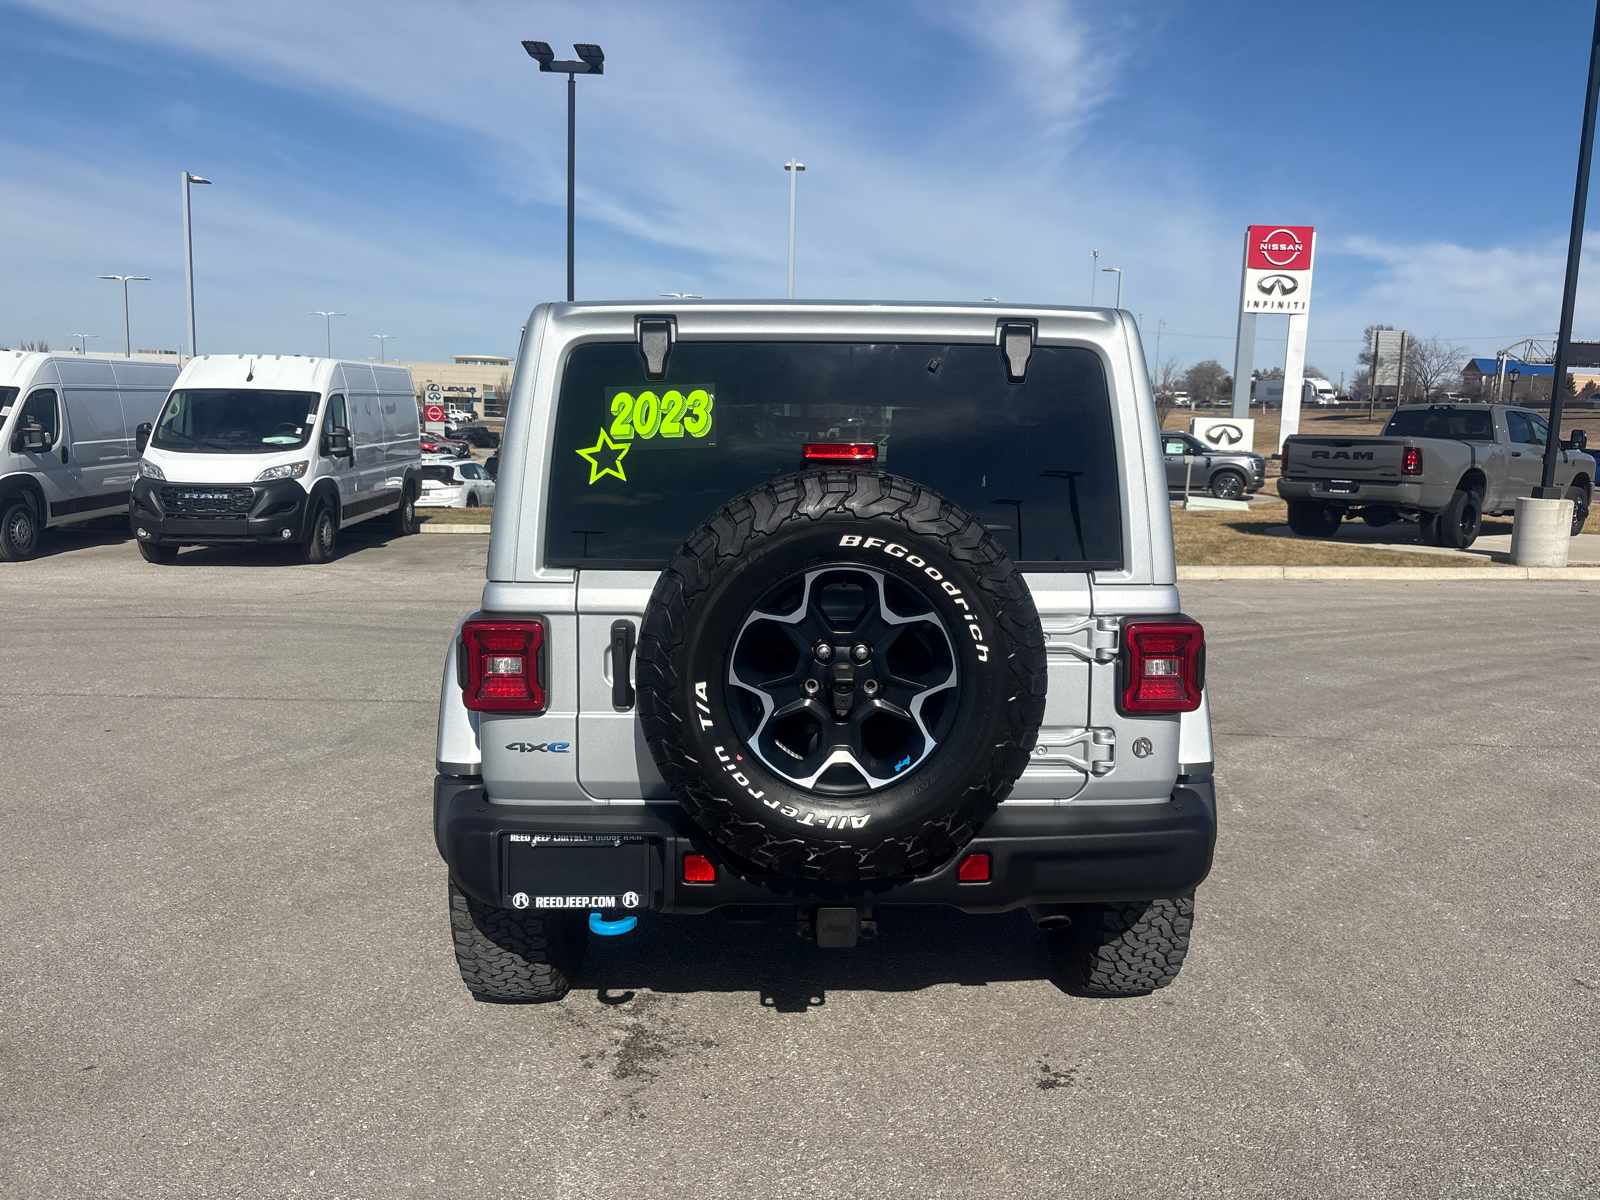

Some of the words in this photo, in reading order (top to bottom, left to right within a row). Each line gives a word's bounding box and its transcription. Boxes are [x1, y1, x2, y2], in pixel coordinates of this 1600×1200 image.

[1260, 243, 1303, 251] NISSAN
[1246, 300, 1306, 310] INFINITI
[610, 389, 714, 440] 2023
[1311, 450, 1375, 461] RAM
[838, 534, 989, 662] BFGoodrich
[693, 681, 714, 732] T/A
[713, 745, 872, 830] All-Terrain
[510, 834, 531, 842] REED
[533, 834, 551, 842] JEEP
[553, 834, 593, 842] CHRYSLER
[595, 834, 621, 842] DODGE
[623, 834, 642, 842] RAM
[535, 896, 616, 908] REEDJEEP.COM
